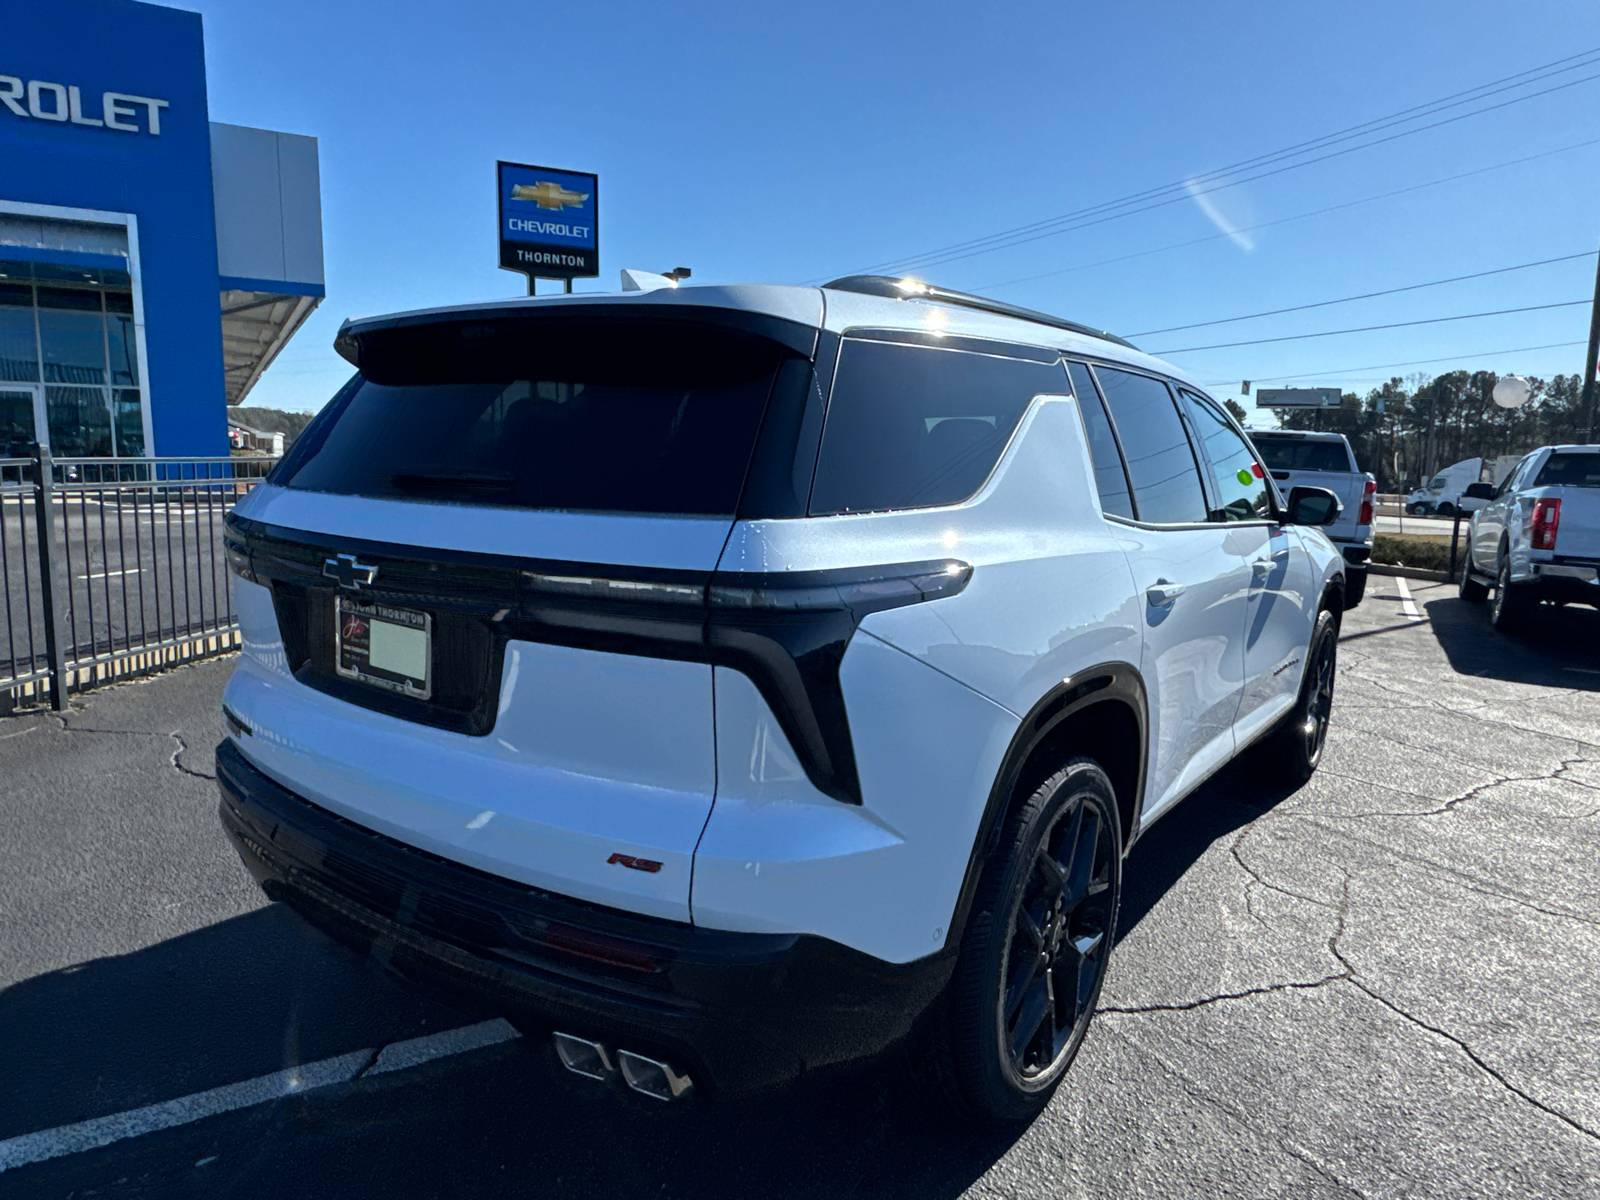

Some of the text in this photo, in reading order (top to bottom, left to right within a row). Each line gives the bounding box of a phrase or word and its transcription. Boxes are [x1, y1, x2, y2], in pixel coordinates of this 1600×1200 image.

[508, 218, 590, 238] CHEVROLET
[517, 250, 585, 267] THORNTON
[377, 606, 425, 625] THORNTON
[607, 853, 664, 873] RS
